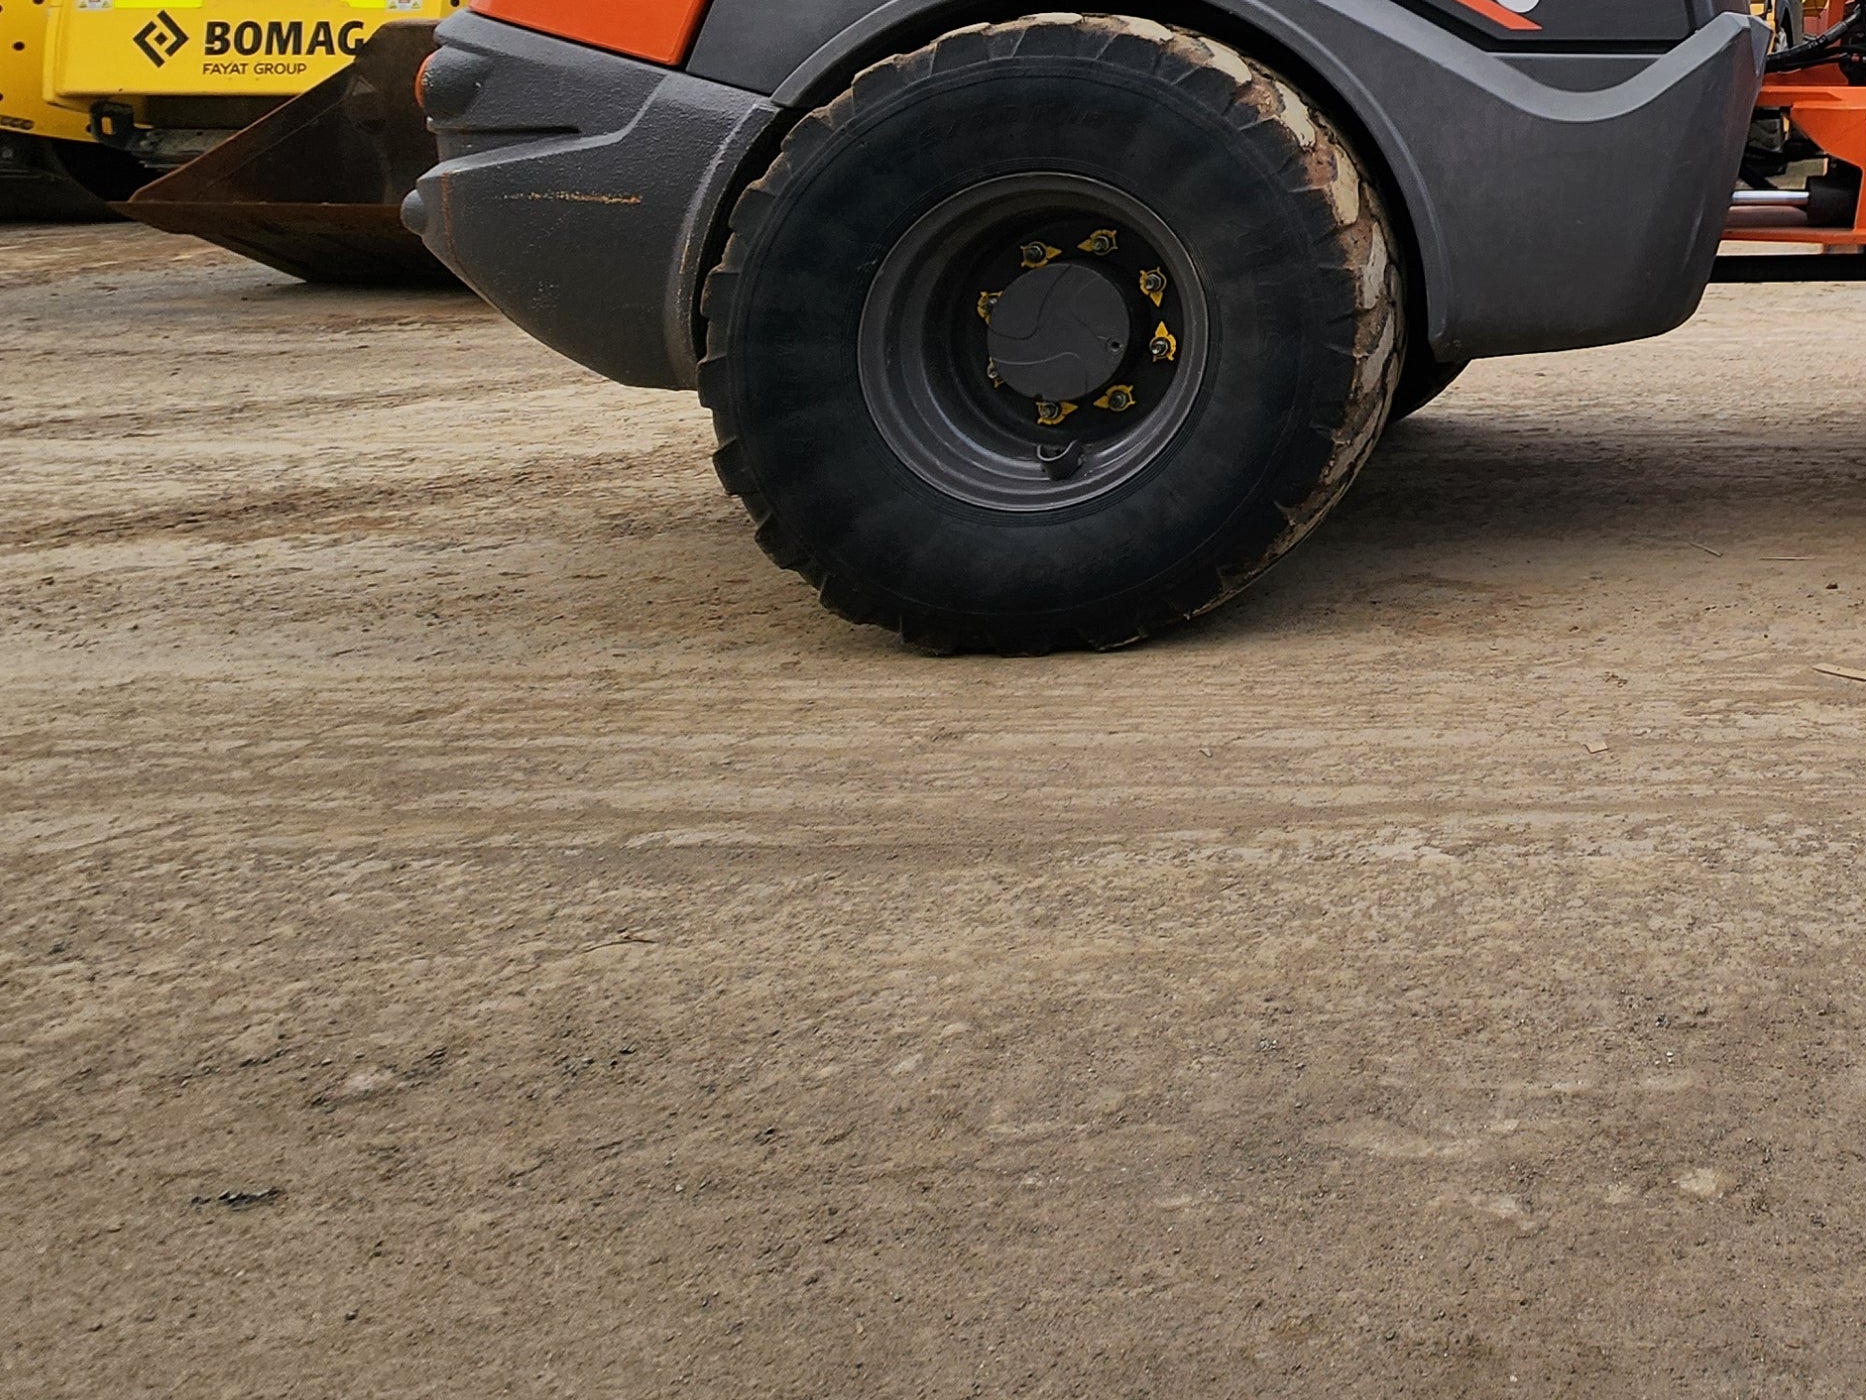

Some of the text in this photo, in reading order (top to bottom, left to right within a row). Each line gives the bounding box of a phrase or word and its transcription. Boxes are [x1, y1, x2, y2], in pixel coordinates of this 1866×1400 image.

[204, 20, 365, 56] BOMAG
[202, 63, 307, 75] FAYAT GROUP
